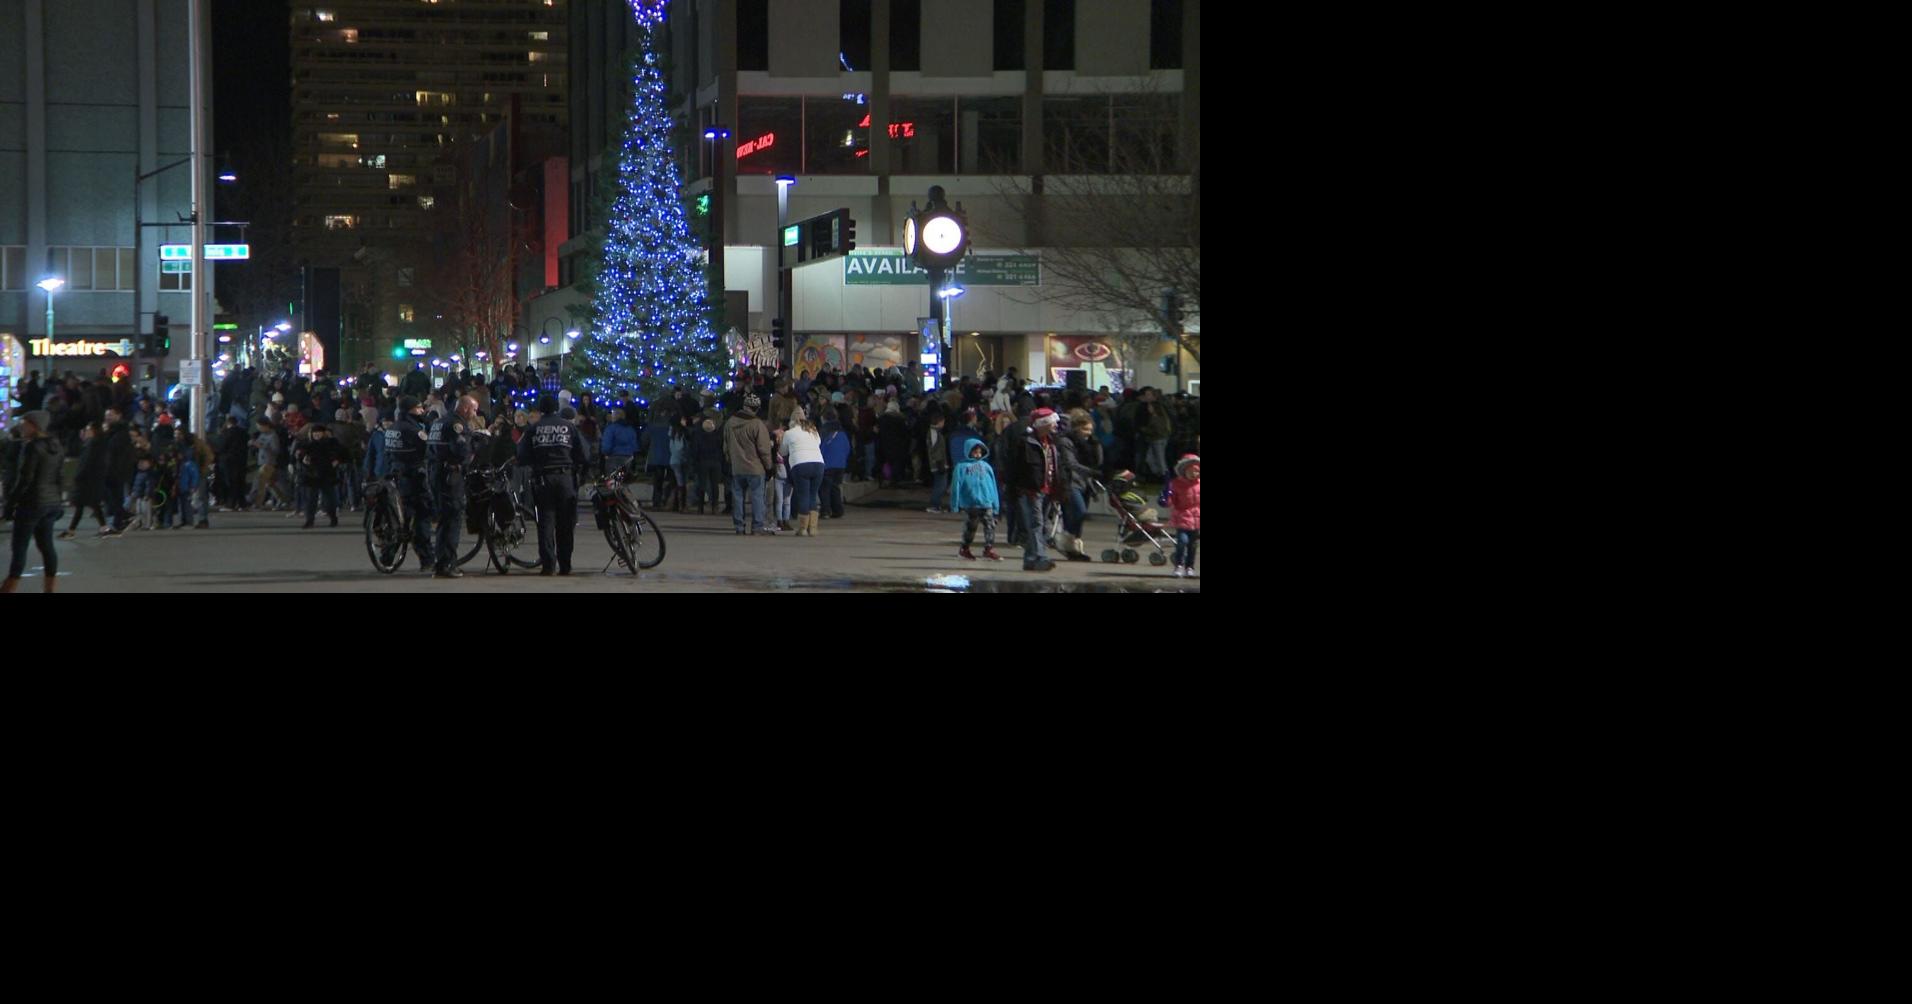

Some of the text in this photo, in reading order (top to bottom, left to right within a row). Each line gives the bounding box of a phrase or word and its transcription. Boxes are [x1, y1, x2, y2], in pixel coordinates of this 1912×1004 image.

[847, 257, 966, 275] AVAILAE
[28, 337, 107, 357] Theatre
[536, 425, 569, 435] RENO
